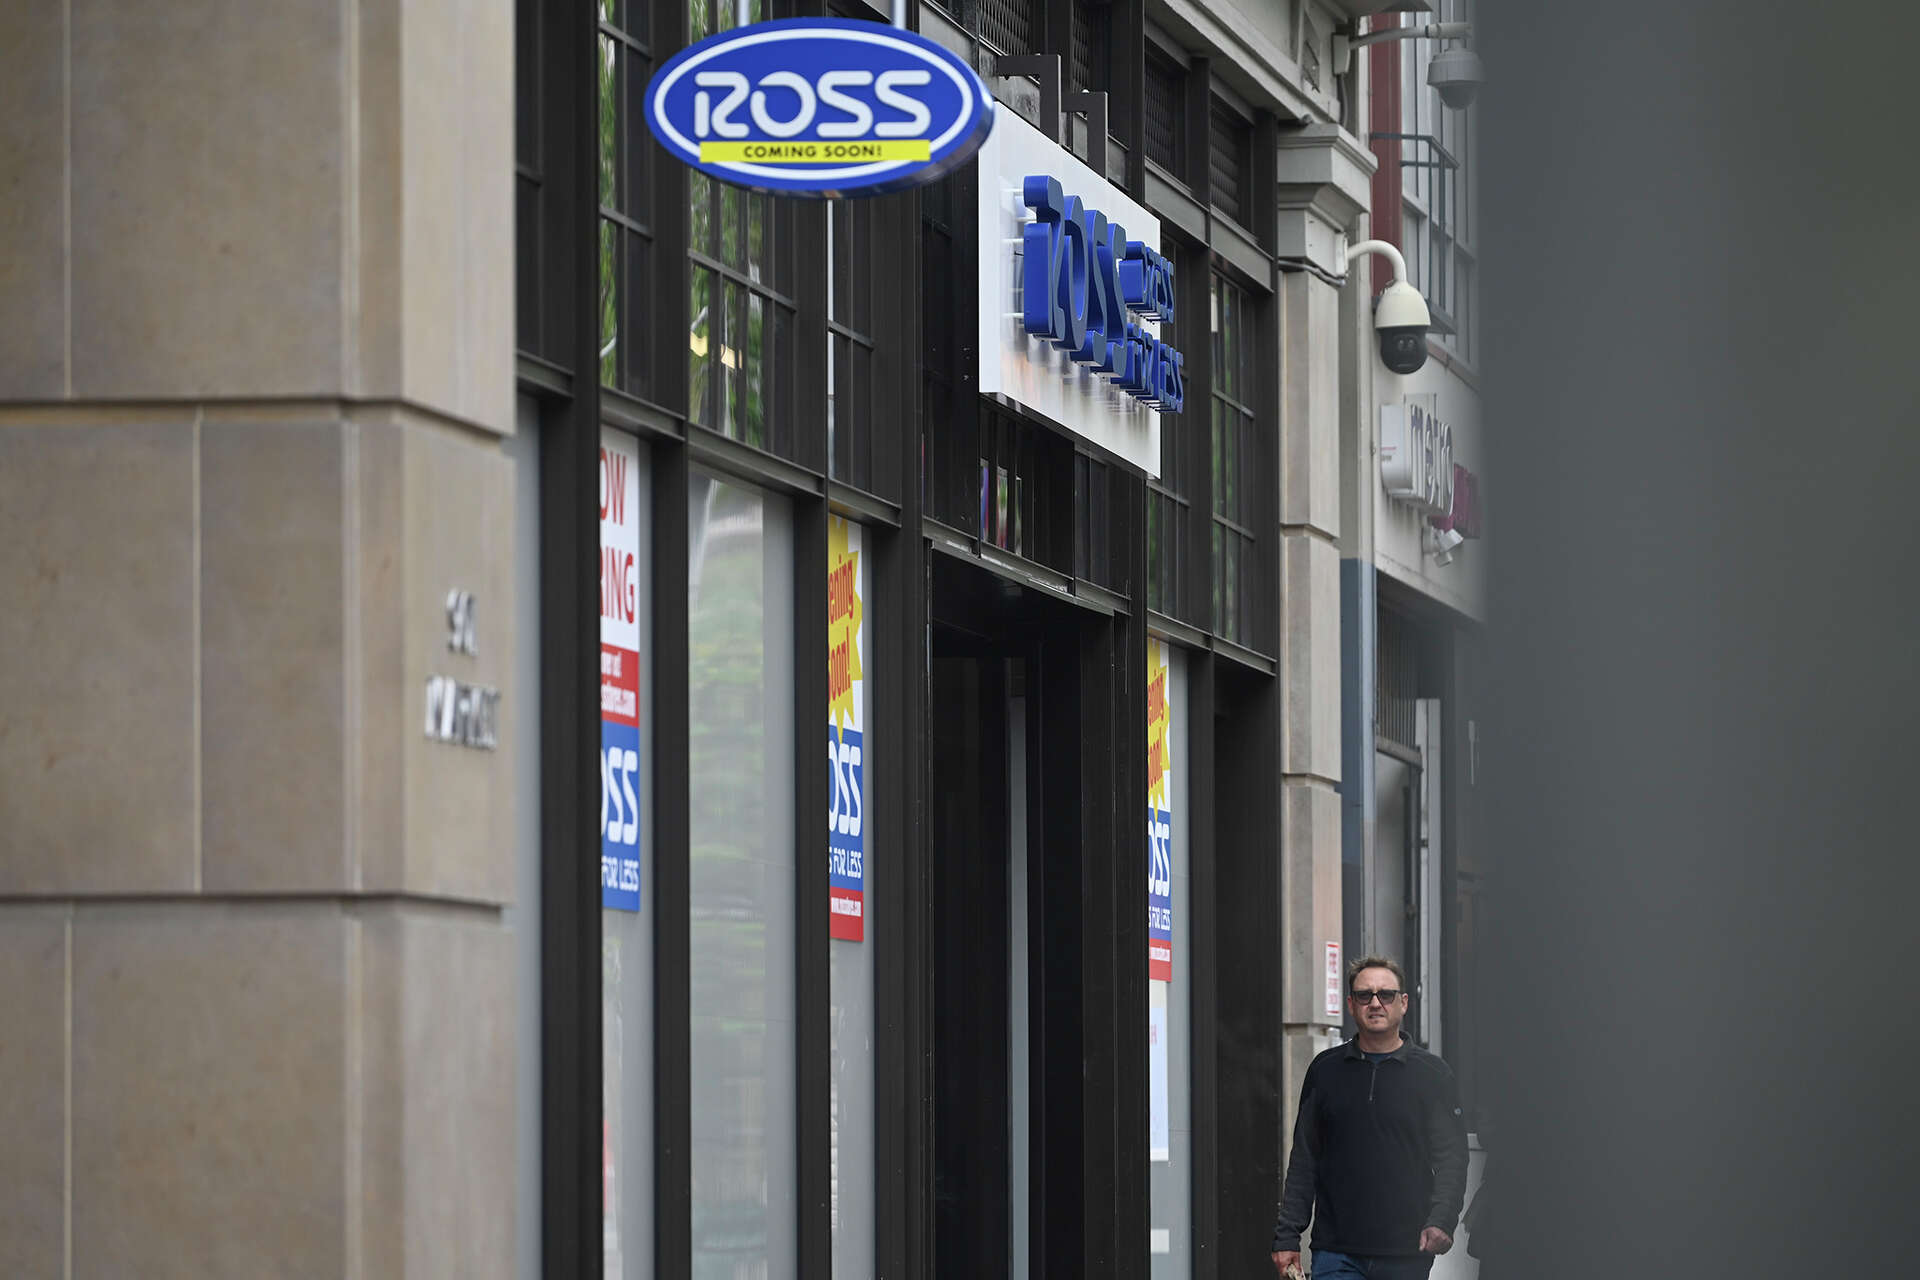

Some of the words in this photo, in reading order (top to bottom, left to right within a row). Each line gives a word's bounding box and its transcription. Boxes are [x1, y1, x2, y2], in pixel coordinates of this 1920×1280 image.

[694, 70, 932, 138] ROSS
[743, 145, 817, 159] COMING
[824, 144, 882, 158] SOON!
